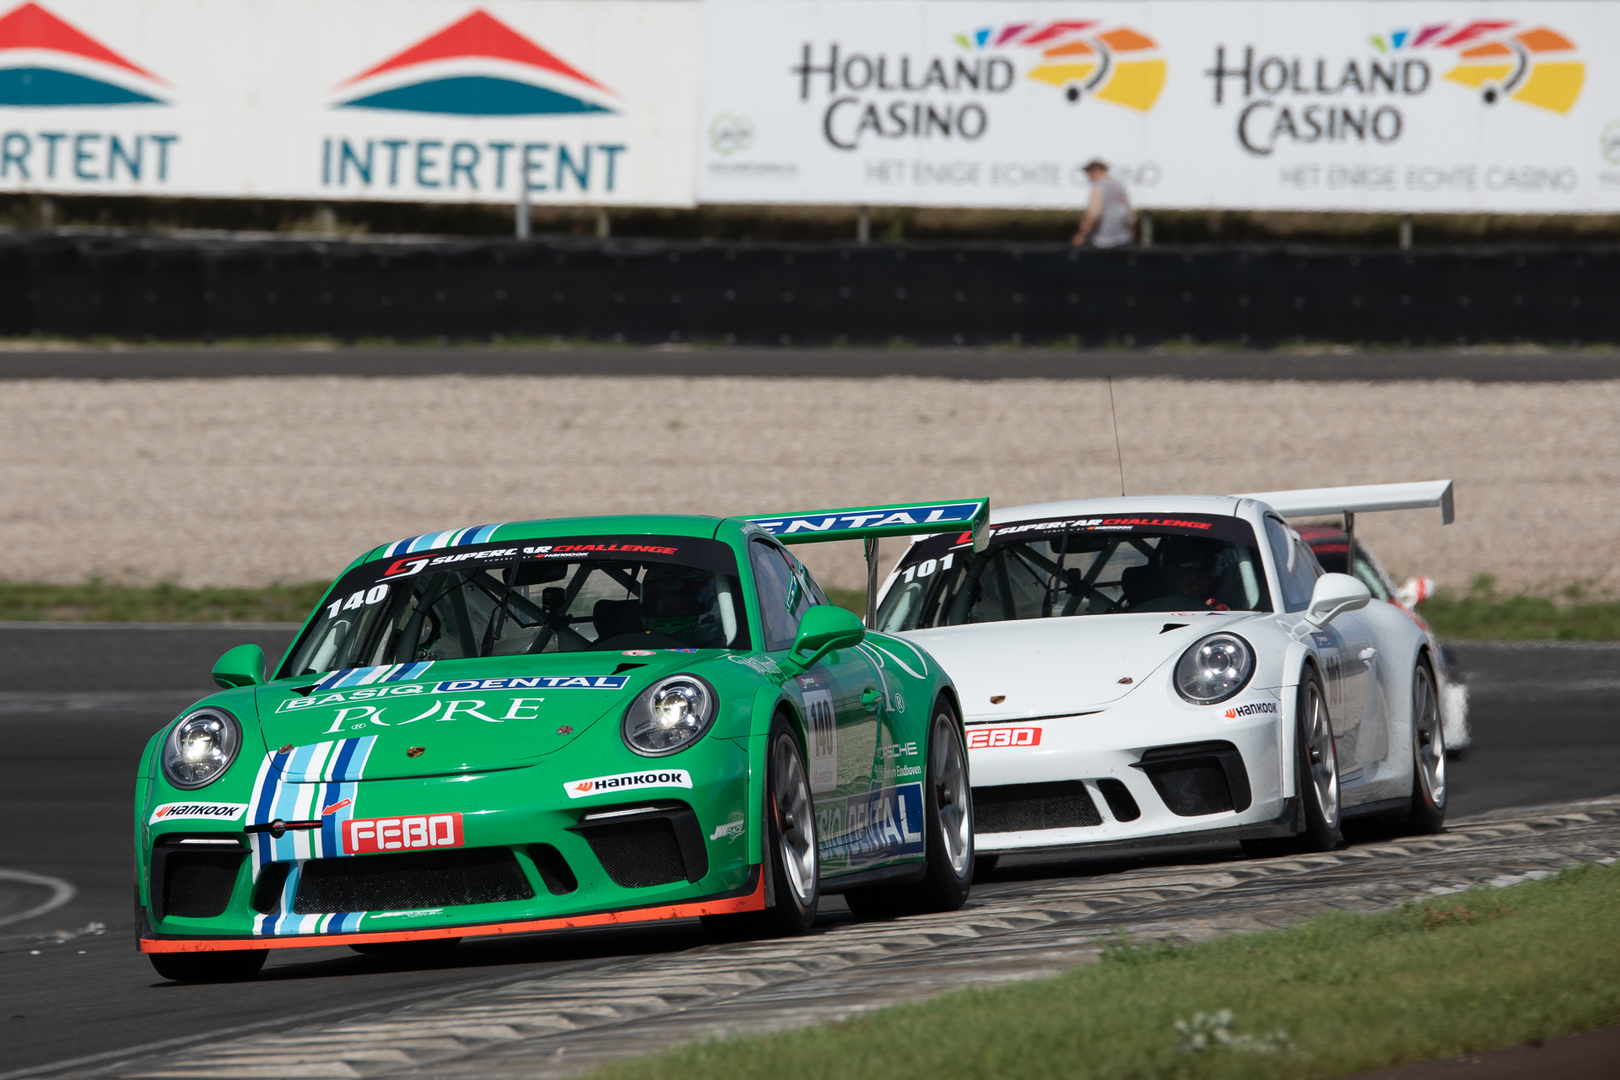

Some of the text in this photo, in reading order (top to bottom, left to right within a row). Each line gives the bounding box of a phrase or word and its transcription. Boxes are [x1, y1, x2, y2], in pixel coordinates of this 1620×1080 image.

[790, 42, 1015, 102] HOLLAND
[1205, 45, 1431, 105] HOLLAND
[823, 97, 988, 151] CASINO
[1237, 101, 1404, 157] CASINO
[1, 131, 179, 183] RTENT
[321, 136, 627, 192] INTERTENT
[1485, 163, 1578, 192] CASINO
[552, 544, 678, 555] CHALLENGE
[1102, 518, 1213, 530] CHALLENGE
[902, 553, 955, 584] 101
[327, 584, 390, 619] 140
[286, 677, 620, 710] BASIQ DENTAL
[811, 699, 833, 756] 140
[350, 815, 455, 852] FEBO
[848, 795, 922, 857] DENTAL
